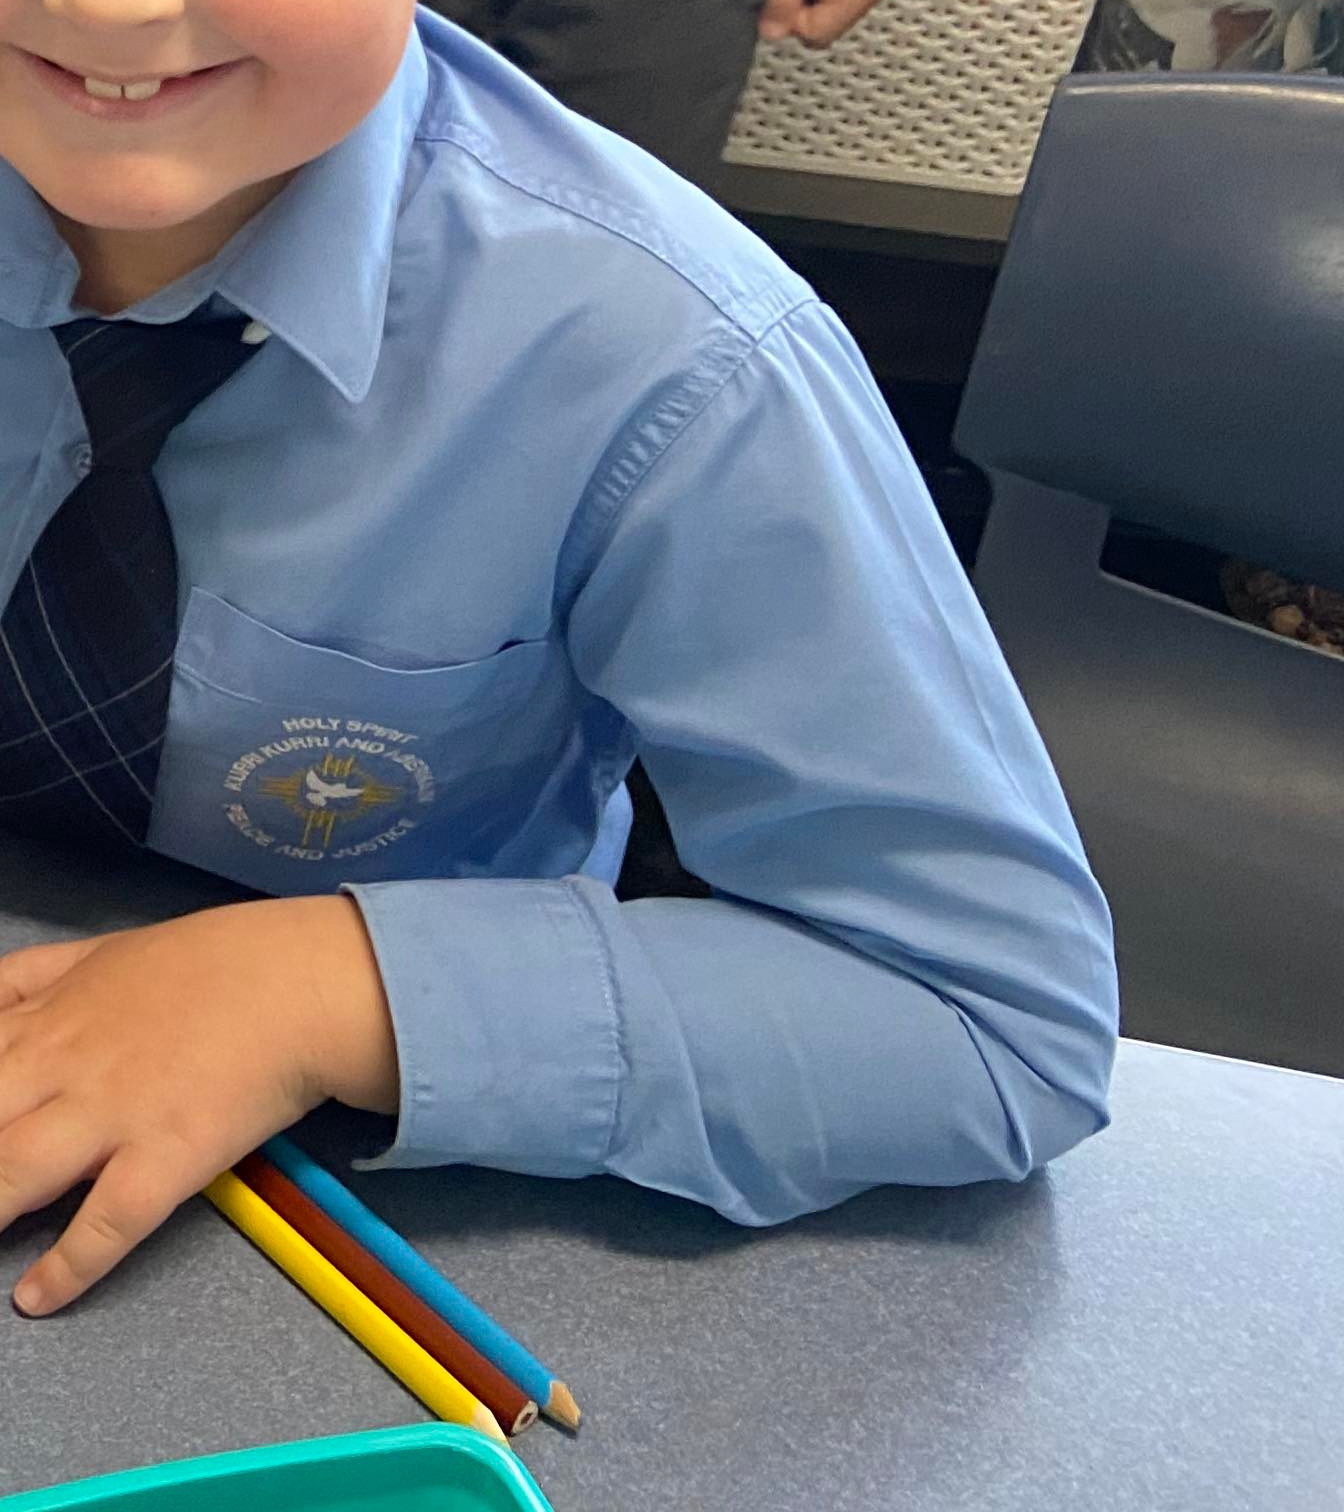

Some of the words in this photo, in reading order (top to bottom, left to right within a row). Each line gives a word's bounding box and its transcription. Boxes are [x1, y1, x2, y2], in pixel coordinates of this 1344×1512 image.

[282, 718, 341, 732] HOLY
[346, 720, 419, 744] SPIRIT
[223, 747, 264, 792] KURRI
[258, 736, 329, 760] KURRI
[334, 736, 385, 755] AND
[274, 843, 324, 861] AND
